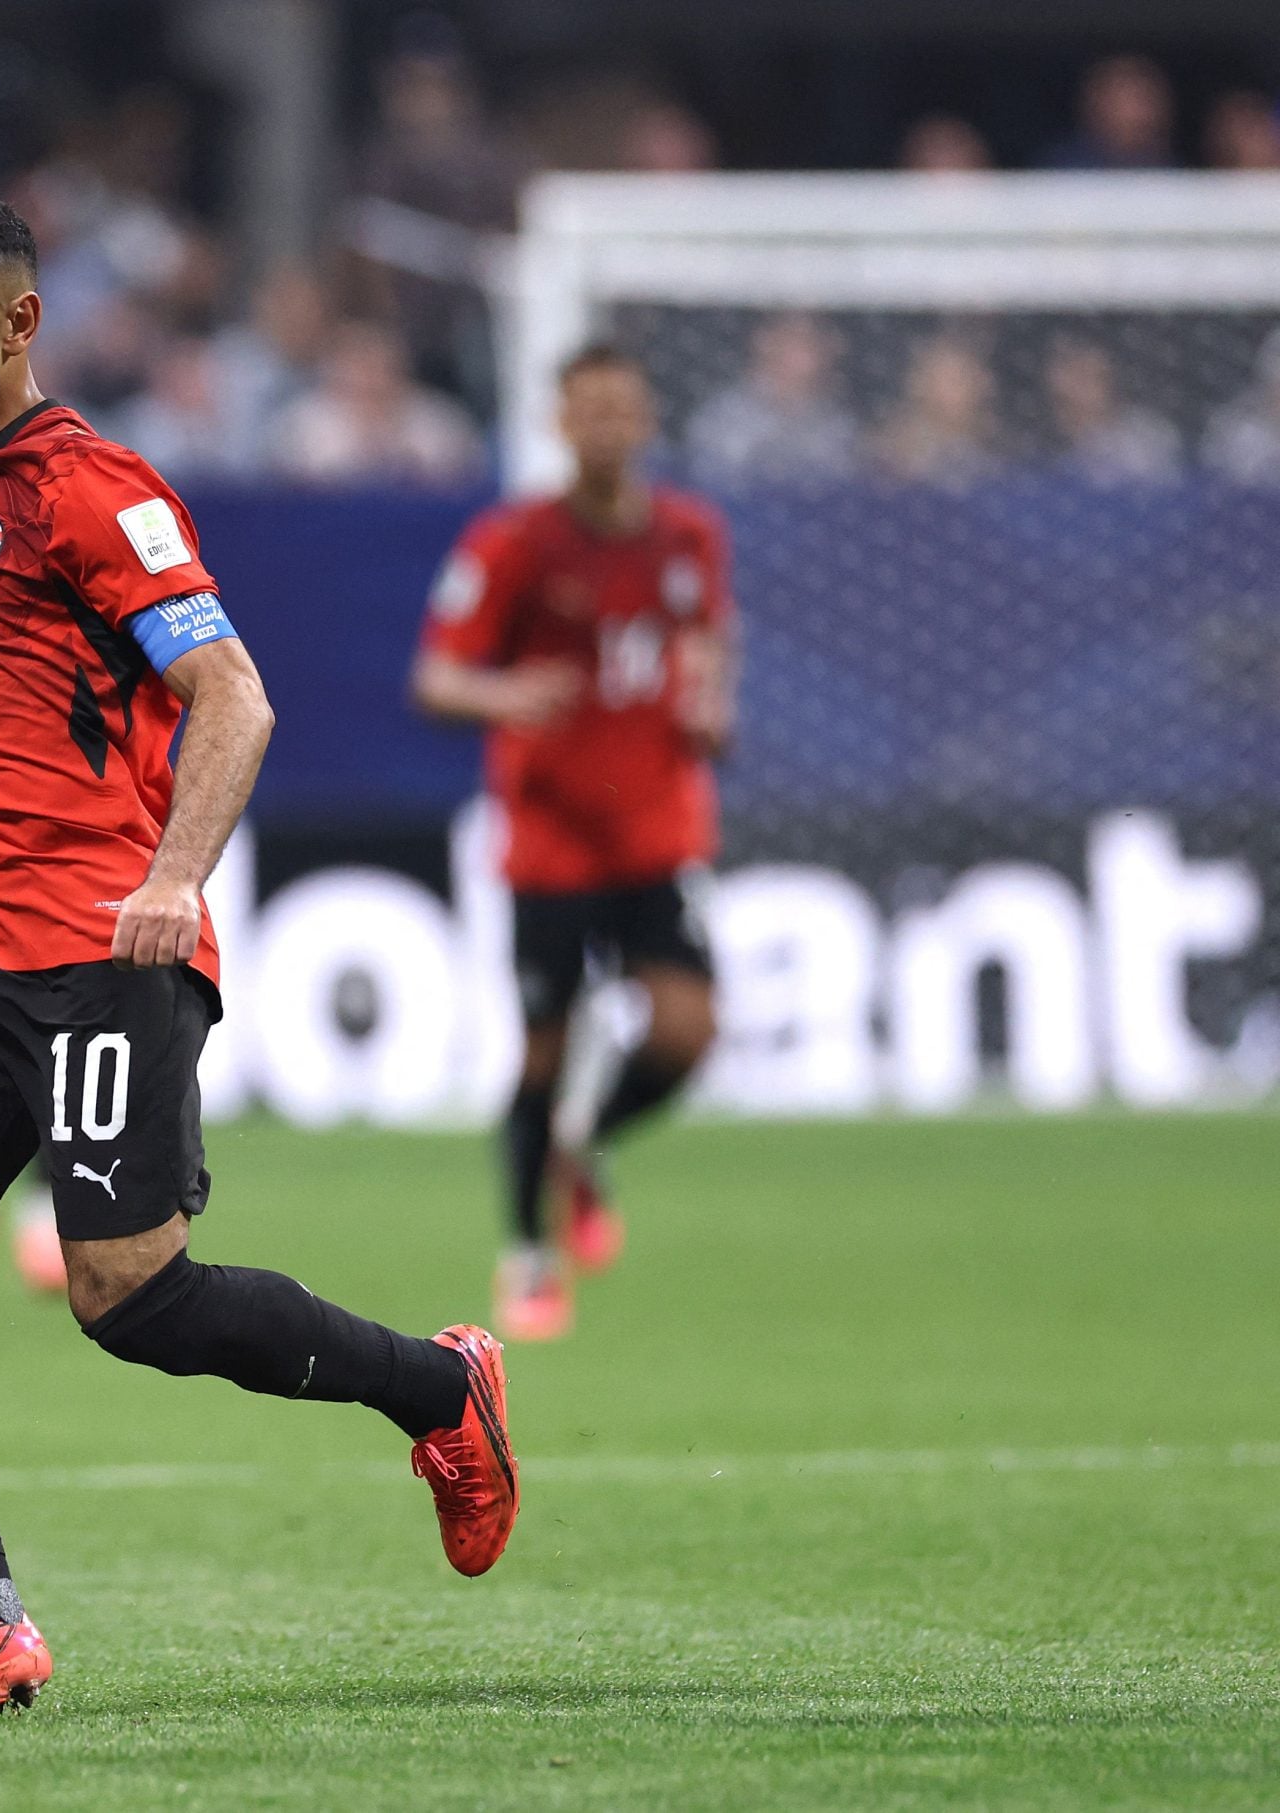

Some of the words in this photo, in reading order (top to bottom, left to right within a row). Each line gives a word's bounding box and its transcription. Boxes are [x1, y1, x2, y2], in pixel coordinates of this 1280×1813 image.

[159, 592, 217, 622] UNITES
[168, 620, 192, 638] the
[190, 607, 225, 628] World
[195, 627, 215, 639] FIFA
[50, 1032, 131, 1141] 10
